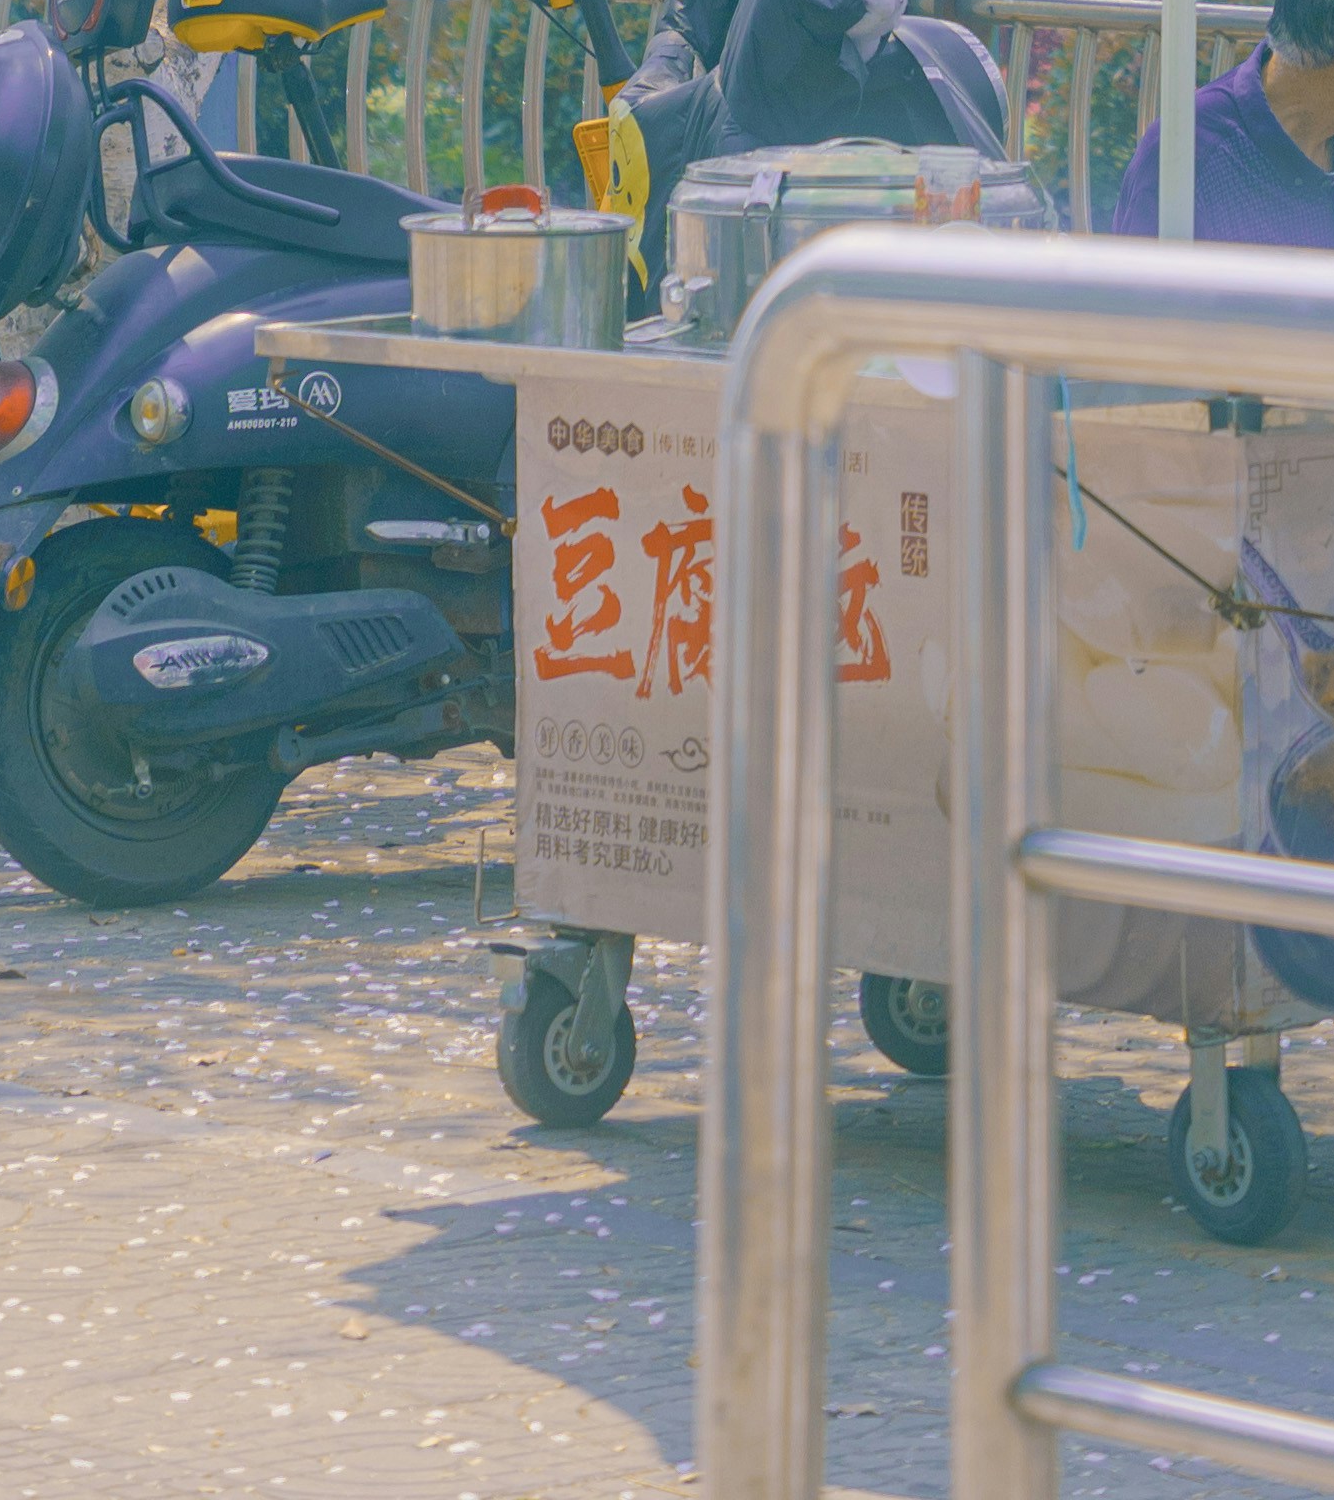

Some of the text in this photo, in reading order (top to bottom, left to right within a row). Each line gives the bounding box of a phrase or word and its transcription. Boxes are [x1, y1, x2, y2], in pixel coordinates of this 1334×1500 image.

[227, 386, 290, 413] 爱玛
[549, 418, 644, 457] 中华美食
[901, 493, 928, 577] 传统
[537, 722, 641, 762] 鲜香美味
[535, 802, 632, 840] 精选好原料
[534, 833, 674, 877] 用料考究更放心
